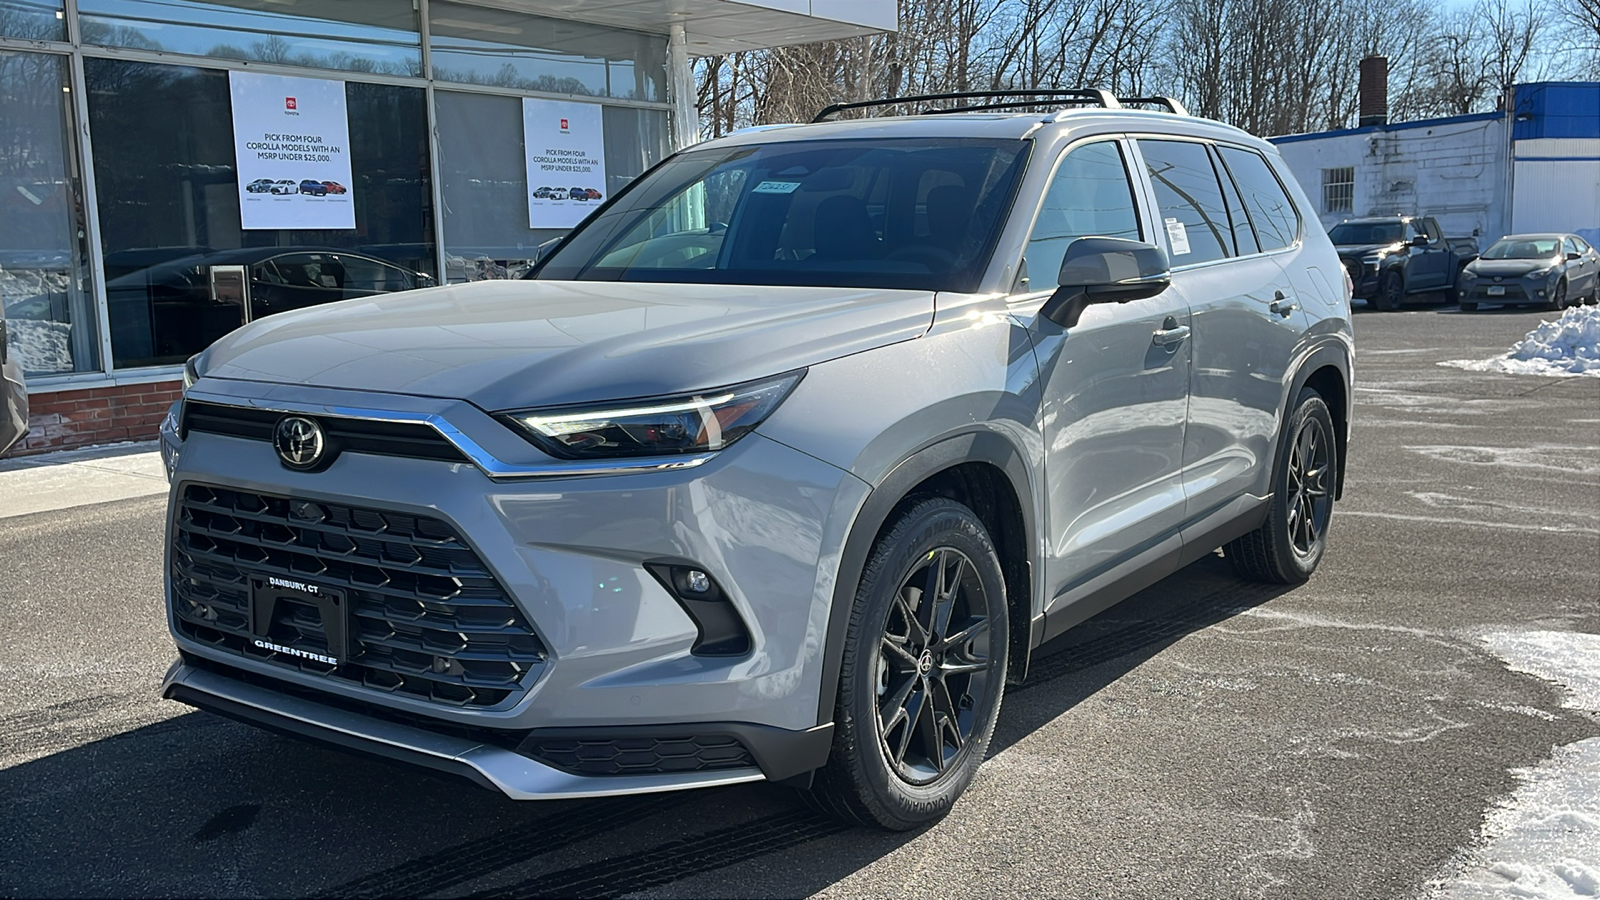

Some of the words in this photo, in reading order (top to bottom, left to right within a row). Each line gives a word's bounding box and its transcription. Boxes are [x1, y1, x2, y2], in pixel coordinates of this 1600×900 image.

[264, 133, 281, 142] PICK
[282, 134, 302, 143] FROM
[303, 135, 322, 144] FOUR
[246, 142, 280, 150] COROLLA
[281, 143, 311, 152] MODELS
[312, 145, 329, 153] WITH
[330, 146, 340, 154] AN
[257, 152, 277, 160] MSRP
[278, 153, 303, 161] UNDER
[304, 155, 331, 163] $25,000.
[558, 157, 578, 165] MODELS
[269, 577, 307, 592] DANBURY,
[307, 585, 318, 593] CT
[254, 640, 338, 665] GREENTREE
[899, 794, 950, 814] YOKOHAMA
